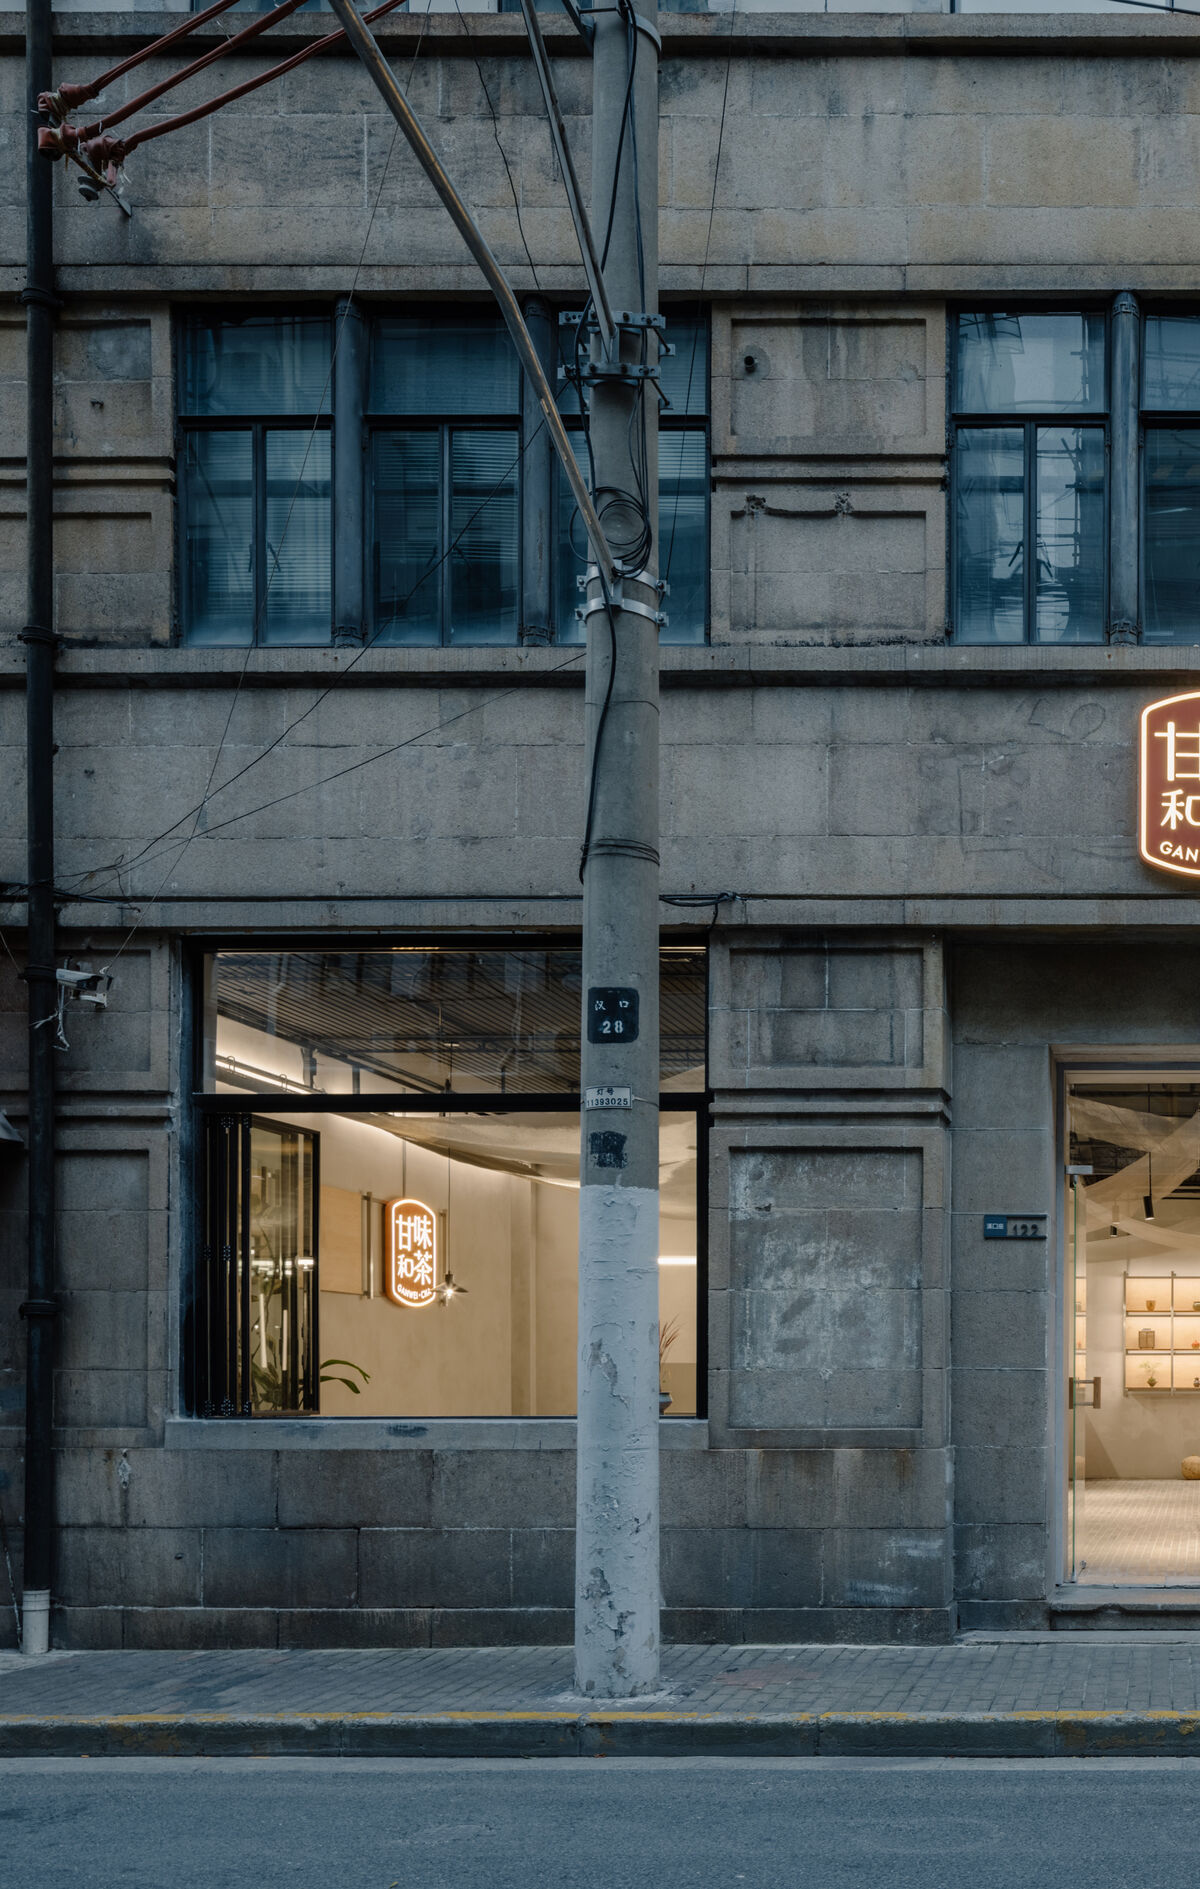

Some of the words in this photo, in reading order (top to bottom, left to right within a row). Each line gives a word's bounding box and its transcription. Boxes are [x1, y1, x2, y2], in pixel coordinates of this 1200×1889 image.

[602, 1020, 624, 1034] 28
[587, 1097, 629, 1106] 11393025
[395, 1214, 432, 1251] 甘味
[397, 1250, 432, 1286] 和茶
